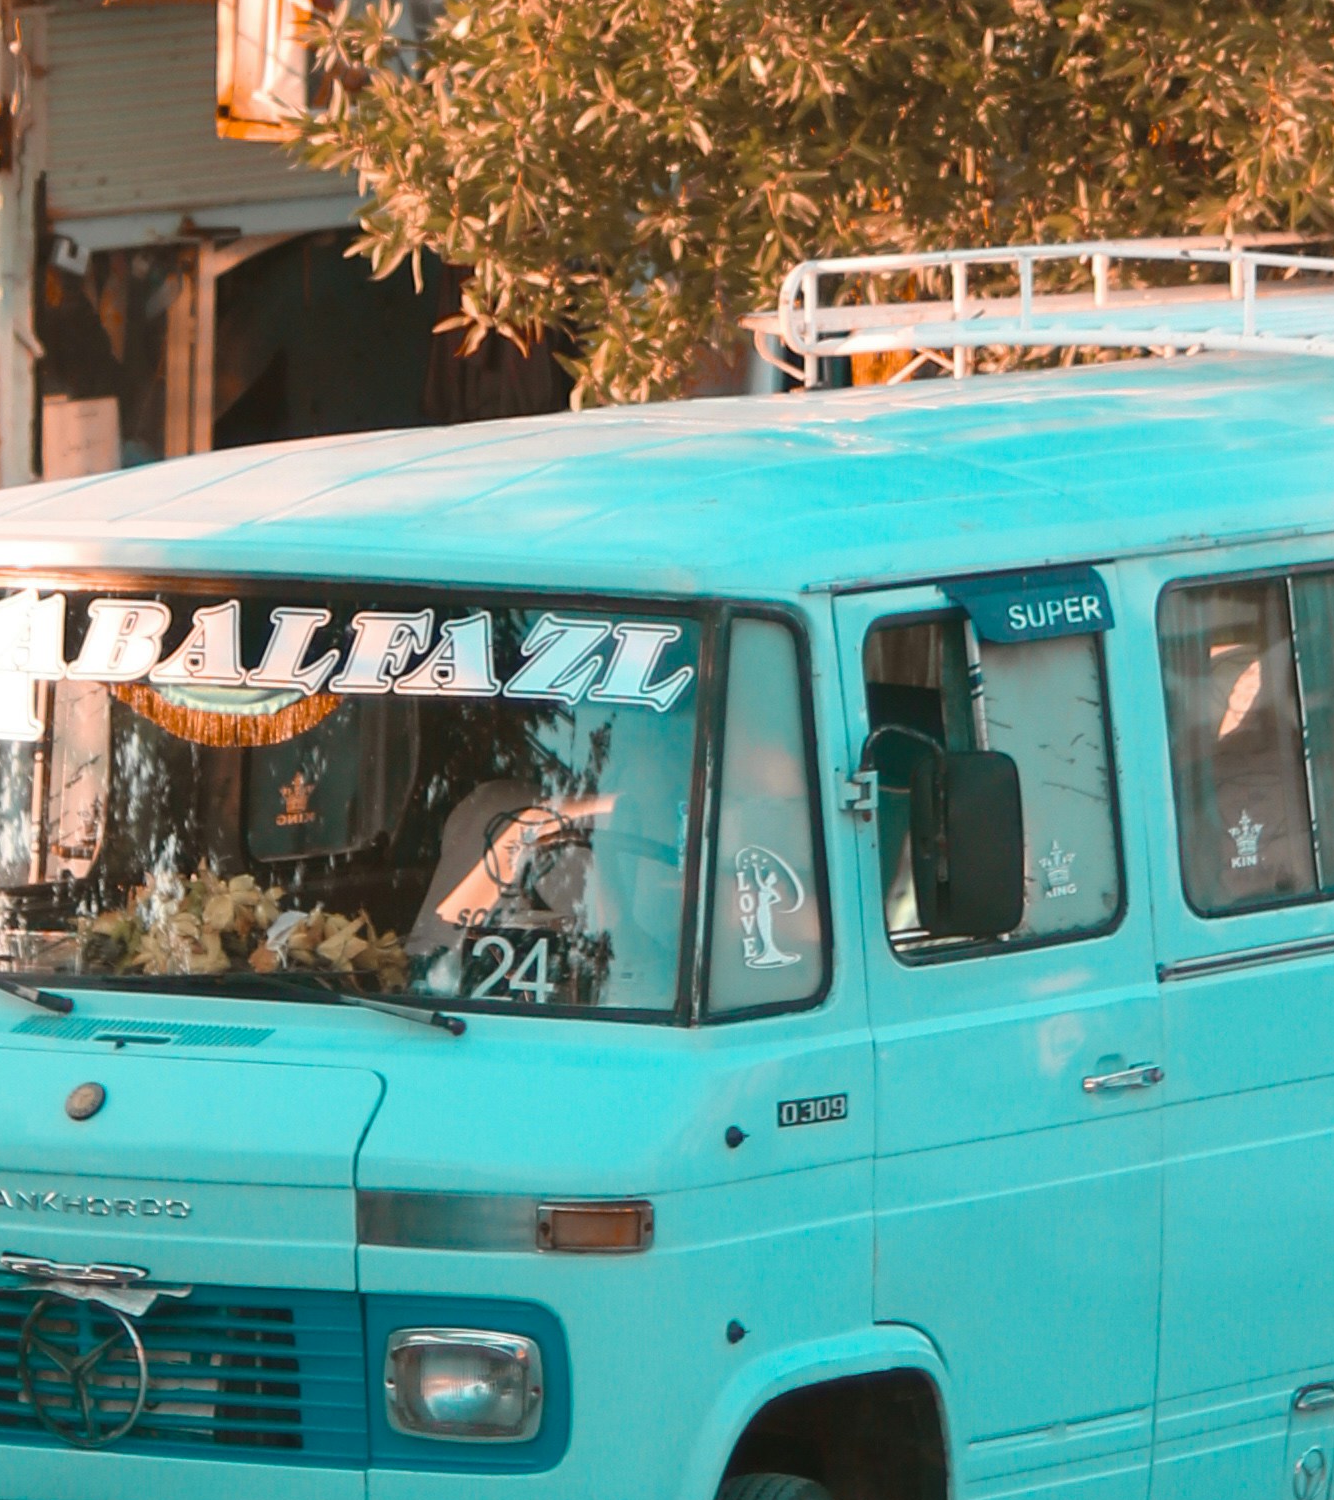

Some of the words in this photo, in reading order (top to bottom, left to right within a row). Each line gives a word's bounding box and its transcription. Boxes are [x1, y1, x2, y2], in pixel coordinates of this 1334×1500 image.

[1008, 594, 1103, 630] SUPER
[1230, 855, 1266, 869] KIN
[735, 871, 758, 959] LOVE
[470, 935, 555, 1004] 24
